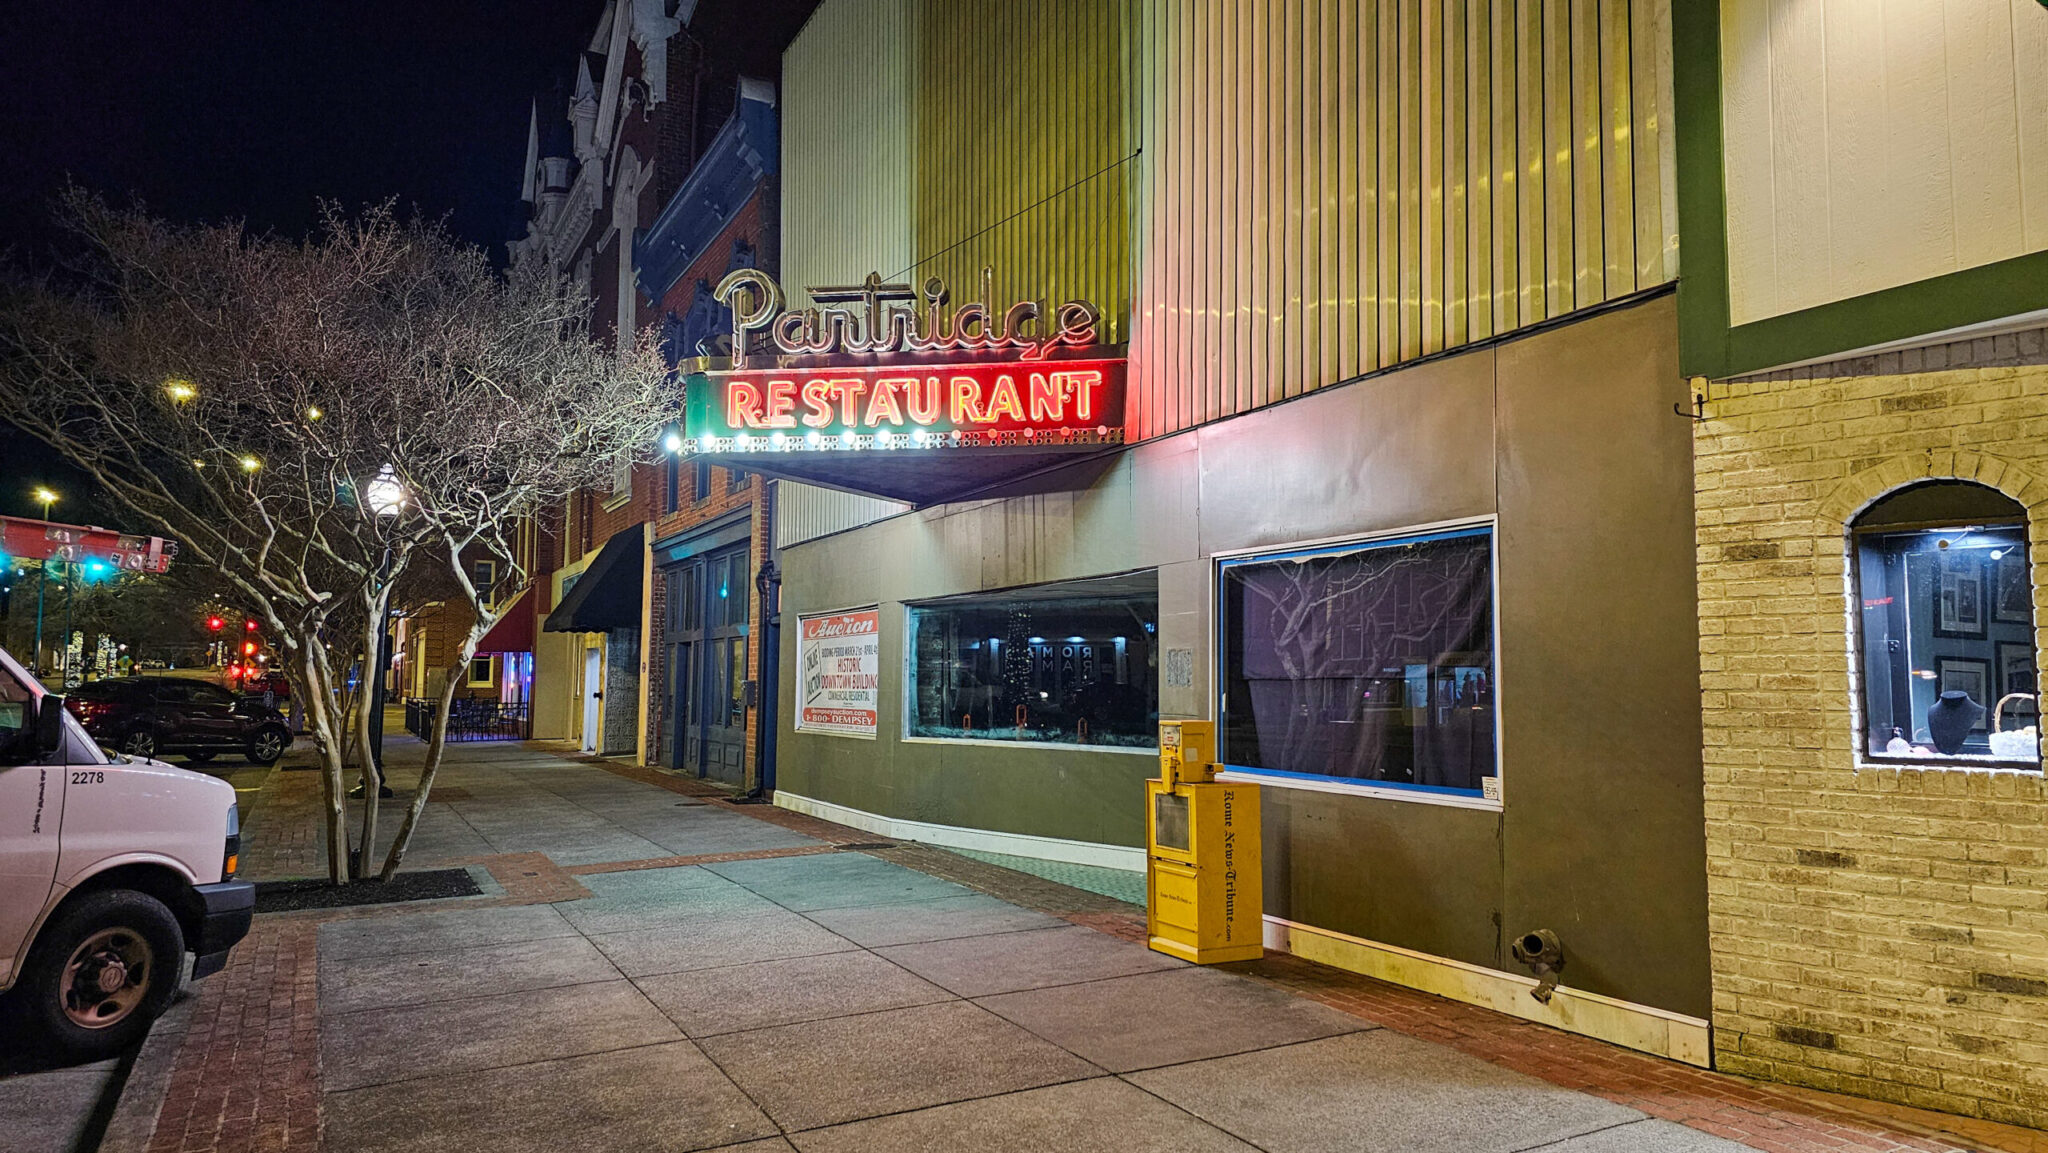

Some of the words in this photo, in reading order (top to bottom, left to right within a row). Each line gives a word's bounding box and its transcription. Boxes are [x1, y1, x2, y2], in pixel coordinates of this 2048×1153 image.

[711, 265, 1102, 370] Partridge
[726, 370, 1103, 429] RESTAURANT
[808, 616, 874, 638] Auction
[837, 657, 862, 672] HISTORIC
[821, 674, 852, 689] DOWNTOWN
[72, 771, 104, 784] 2278
[1223, 789, 1236, 827] Rome
